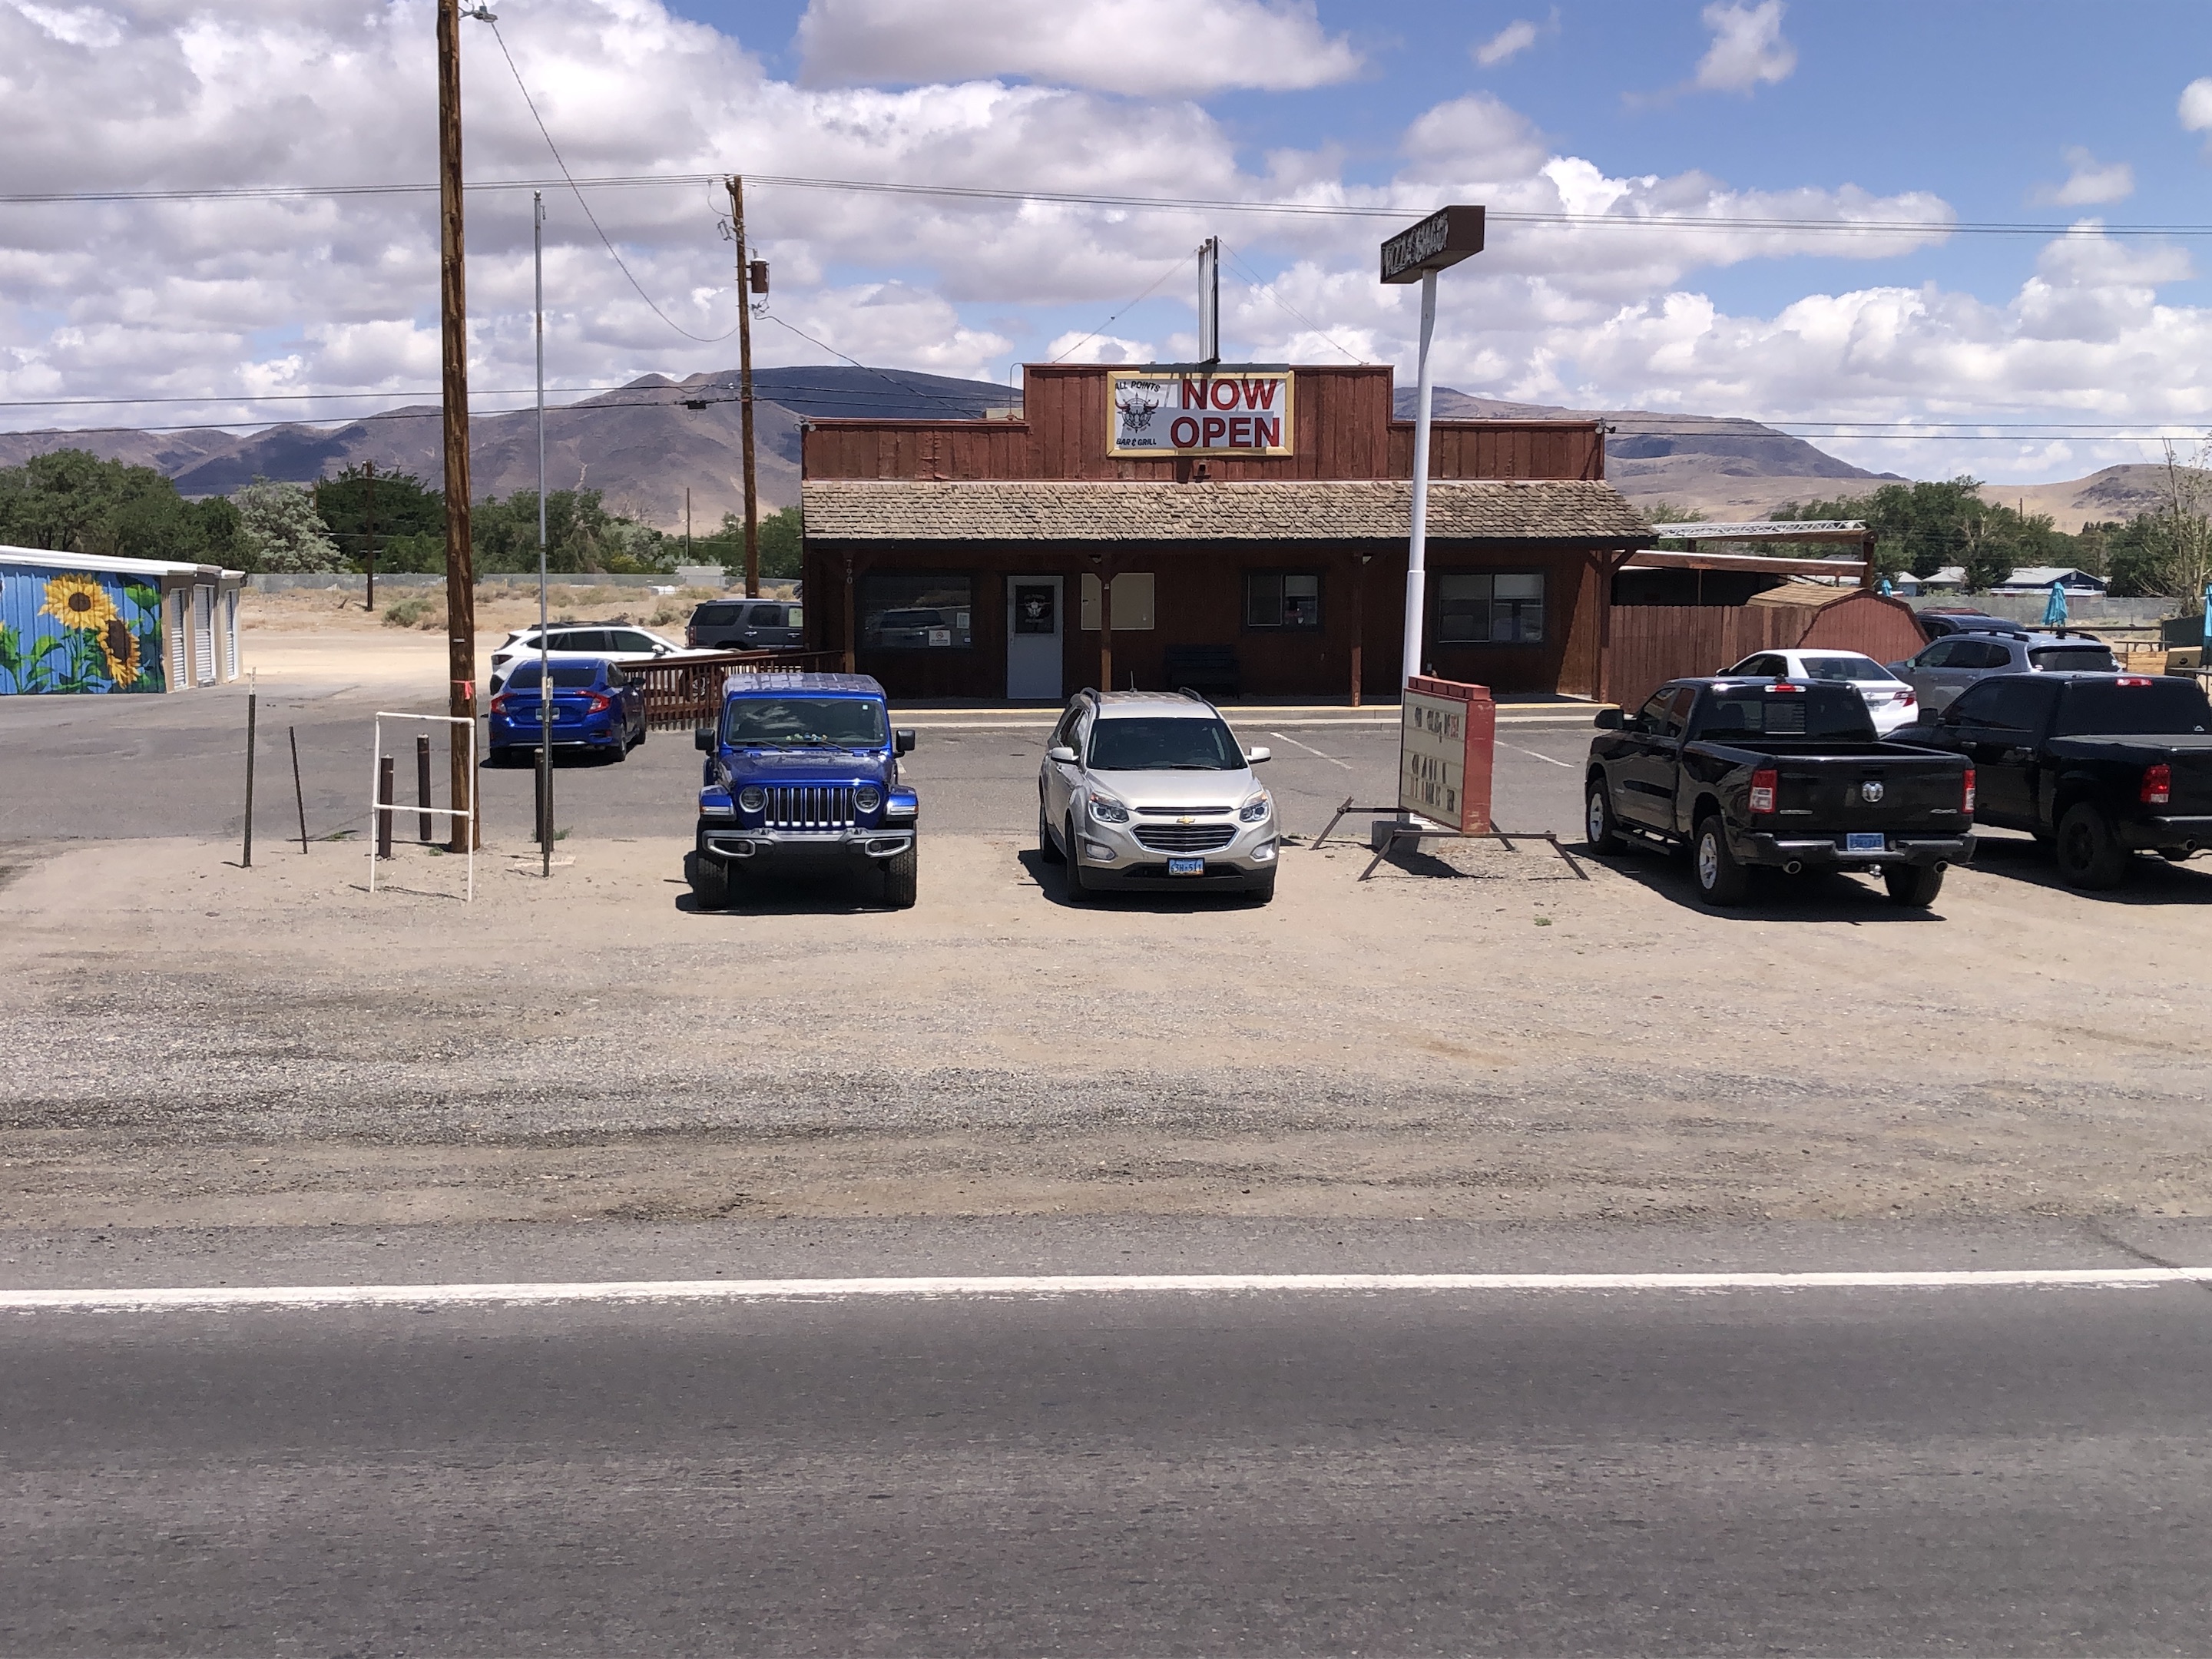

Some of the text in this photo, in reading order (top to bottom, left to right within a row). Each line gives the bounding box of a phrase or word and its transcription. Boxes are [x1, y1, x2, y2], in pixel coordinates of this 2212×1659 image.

[1115, 380, 1161, 392] ALL POINTS
[1182, 379, 1277, 410] NOW
[1131, 438, 1137, 447] &
[1171, 417, 1280, 448] OPEN
